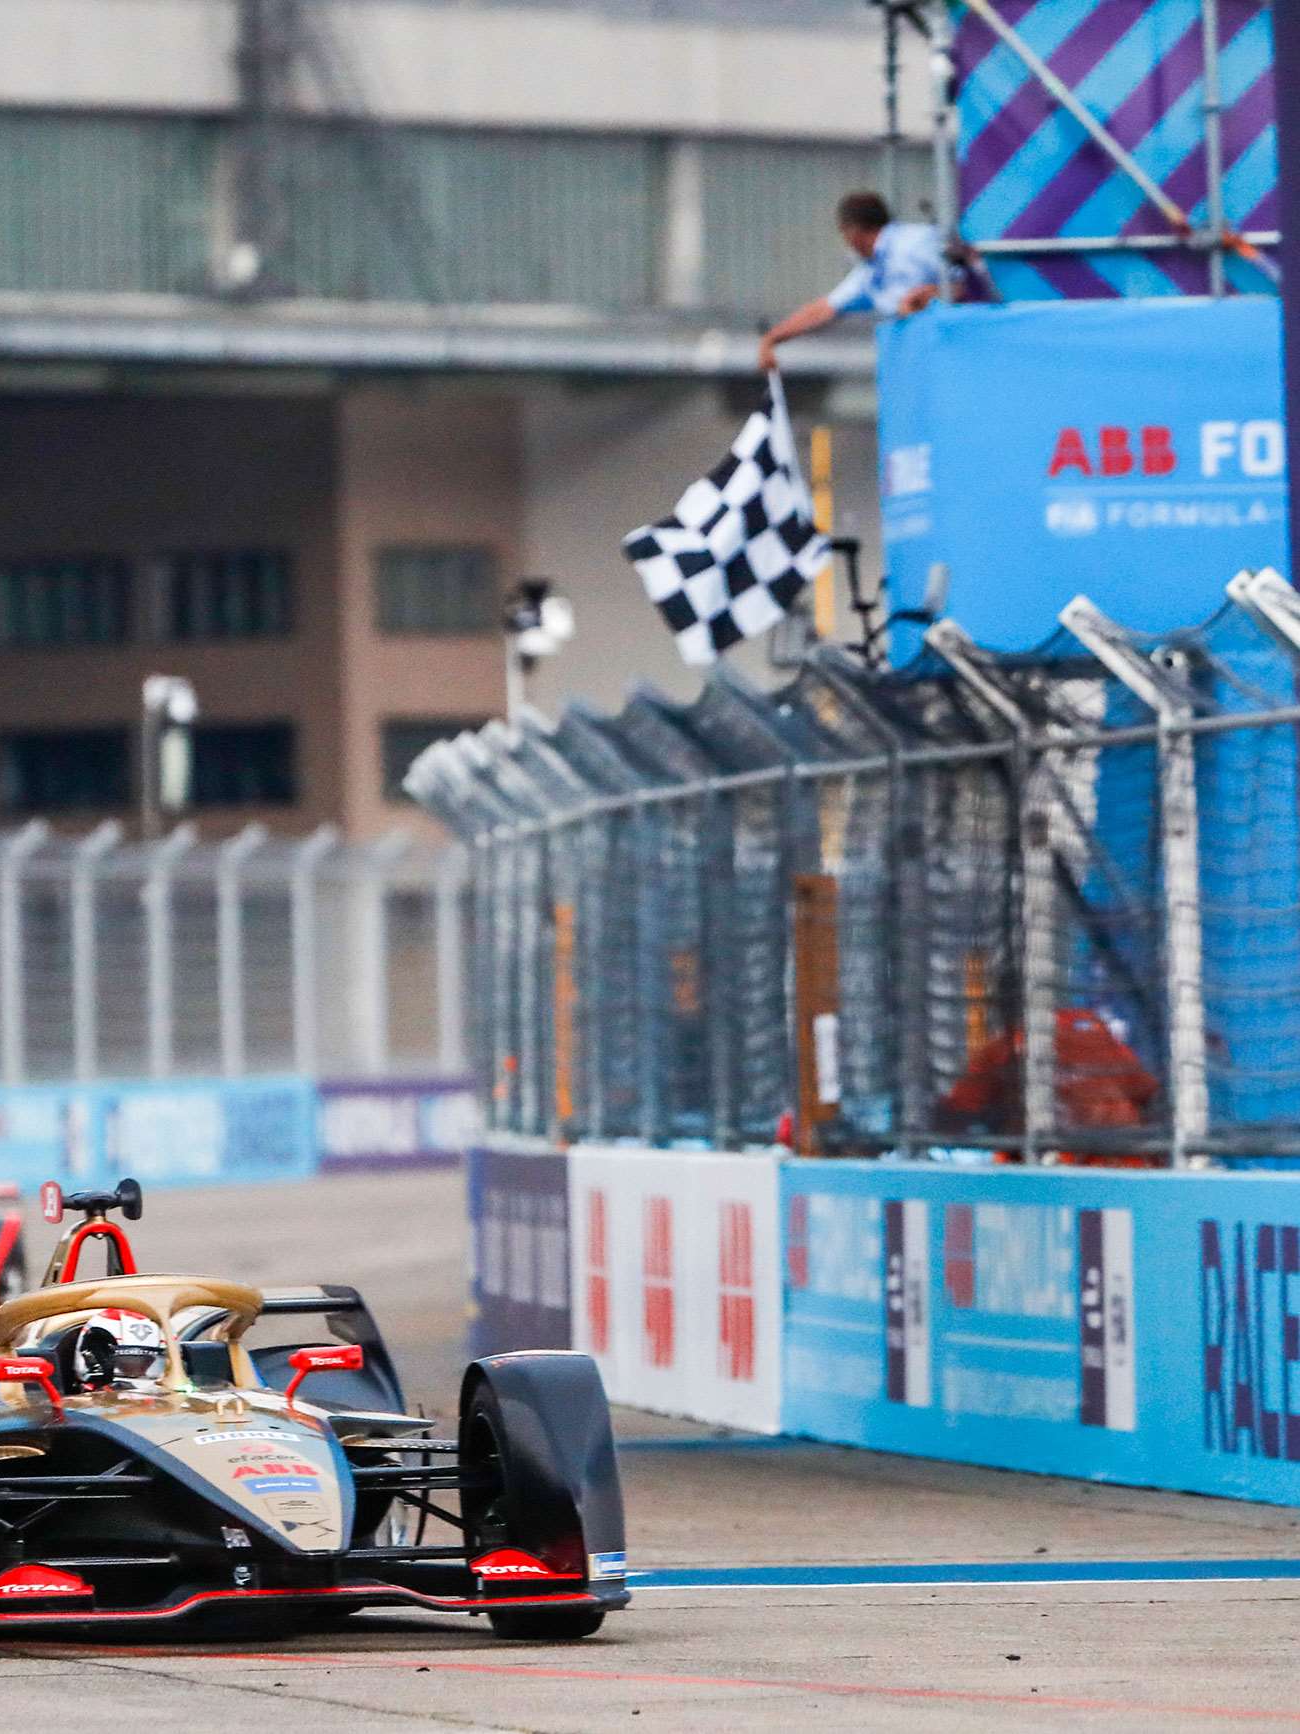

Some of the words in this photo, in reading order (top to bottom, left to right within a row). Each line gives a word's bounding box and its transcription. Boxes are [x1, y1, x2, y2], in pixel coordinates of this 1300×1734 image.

[1047, 426, 1177, 478] ABB
[1201, 420, 1284, 477] FO
[308, 1357, 346, 1366] TOTAL
[4, 1366, 44, 1375] TOTAL
[232, 1464, 319, 1479] ABB
[472, 1565, 549, 1575] TOTAL
[0, 1584, 74, 1593] TOTAL
